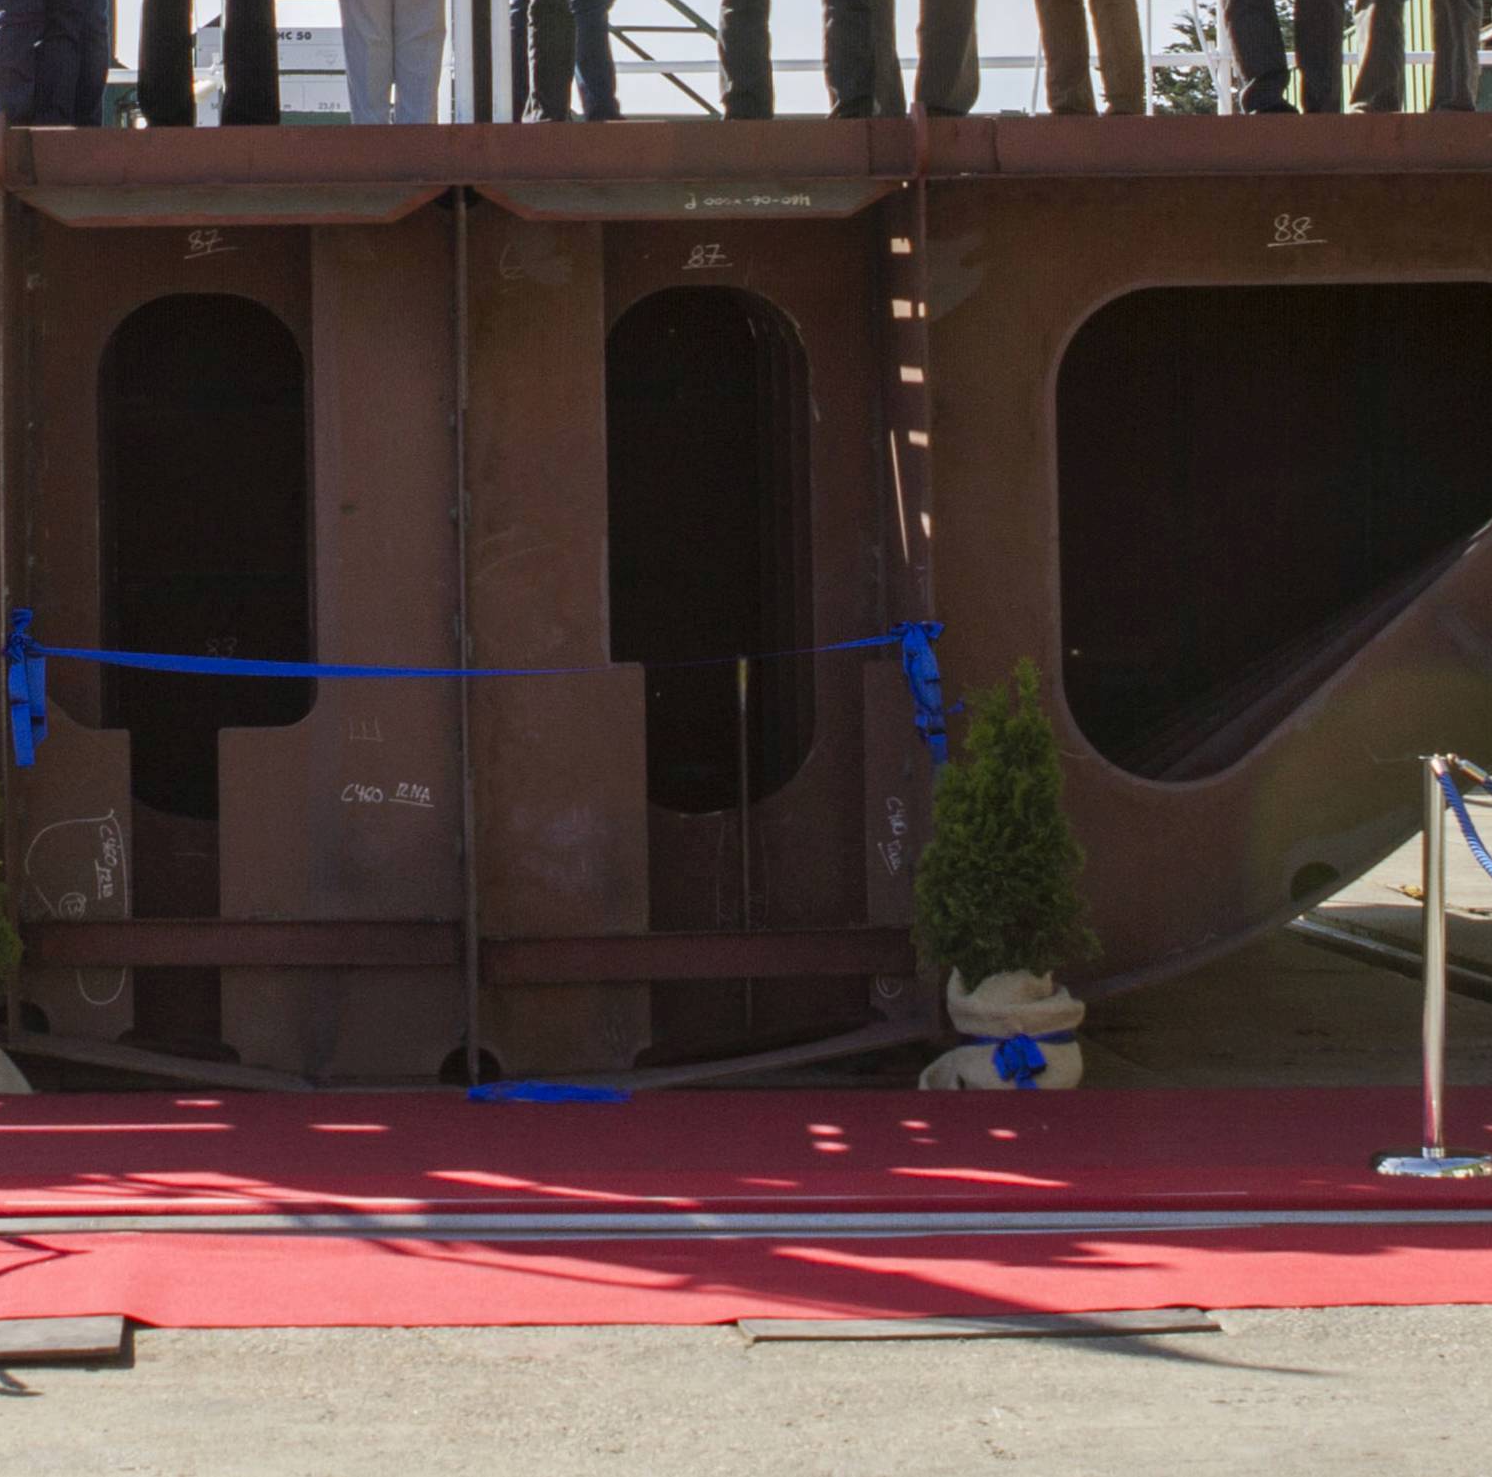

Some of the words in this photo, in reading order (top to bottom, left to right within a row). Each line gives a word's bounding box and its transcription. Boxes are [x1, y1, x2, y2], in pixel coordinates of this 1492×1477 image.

[188, 228, 224, 253] 87
[1274, 213, 1312, 243] 88
[687, 243, 728, 267] 87
